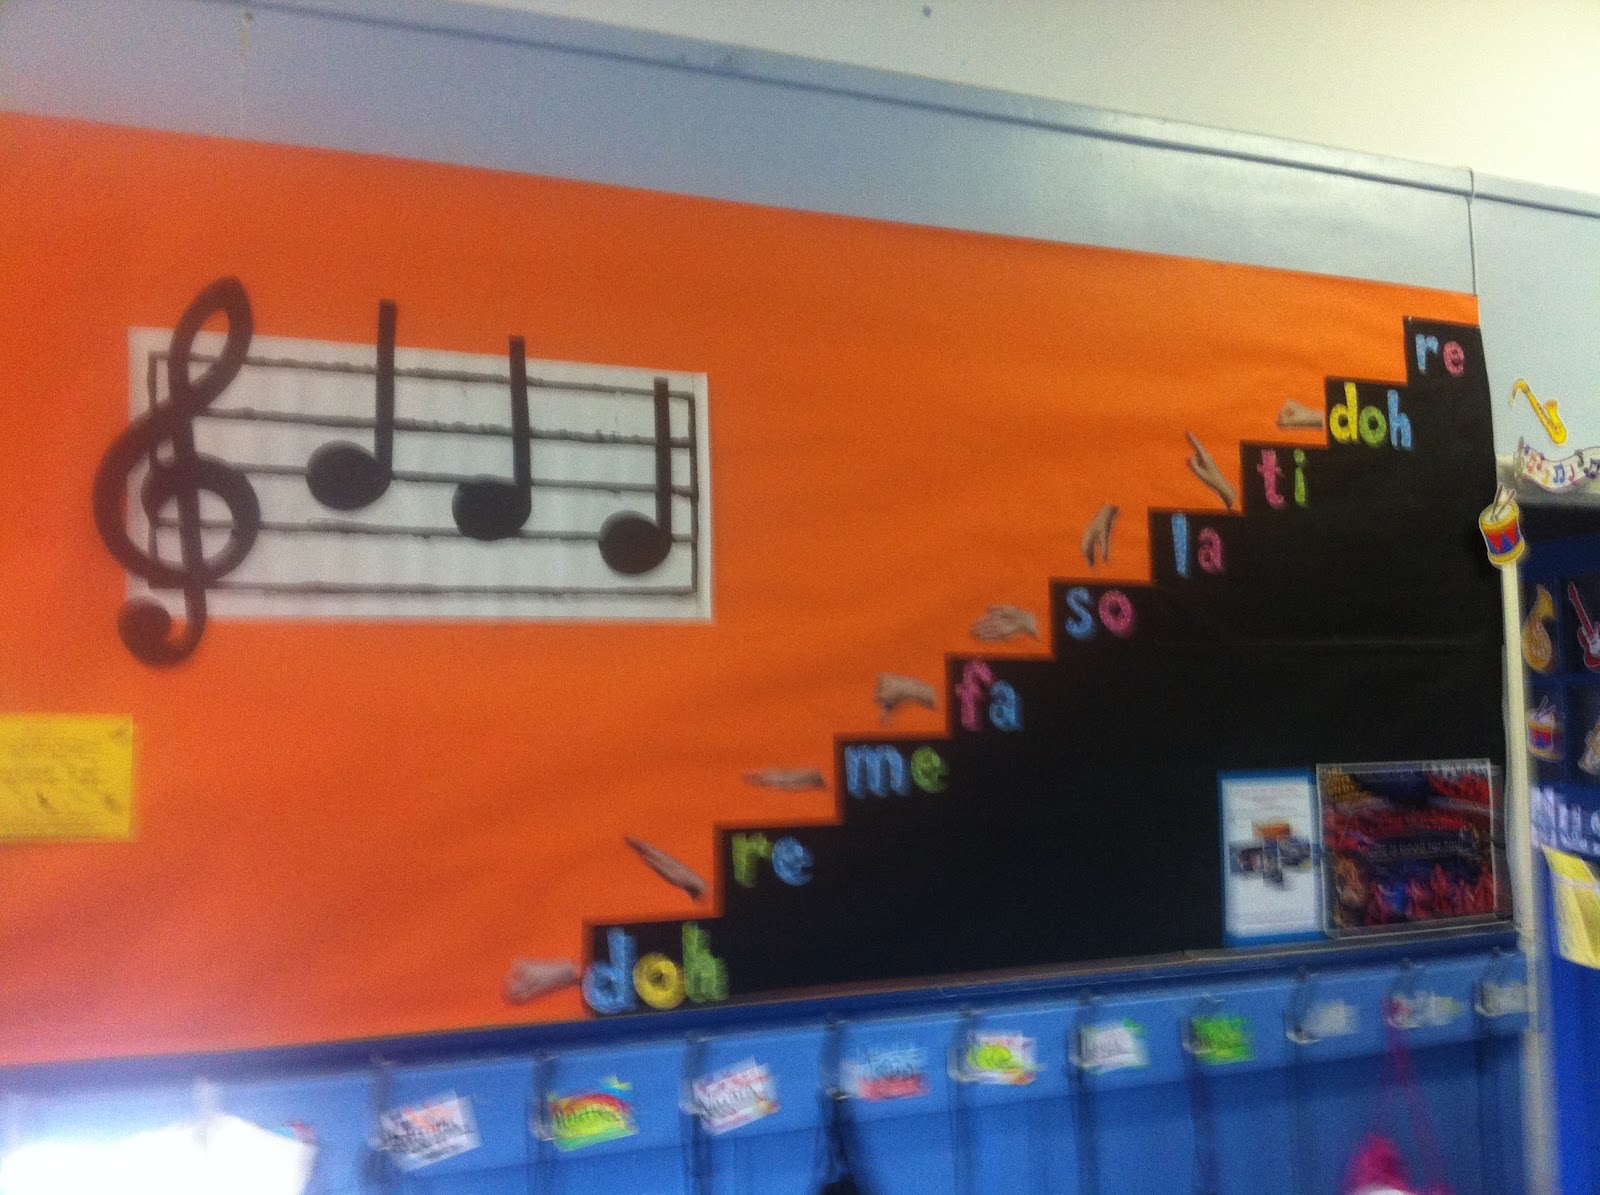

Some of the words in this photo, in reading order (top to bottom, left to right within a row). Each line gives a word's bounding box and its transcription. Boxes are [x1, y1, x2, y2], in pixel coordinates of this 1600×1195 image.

[1415, 333, 1465, 376] re
[1329, 382, 1414, 450] doh
[1257, 448, 1307, 508] ti
[1171, 513, 1225, 577] la
[1065, 586, 1136, 639] so
[956, 660, 1023, 731] fa
[844, 744, 950, 797] me
[732, 832, 814, 888] re
[582, 921, 728, 1014] doh
